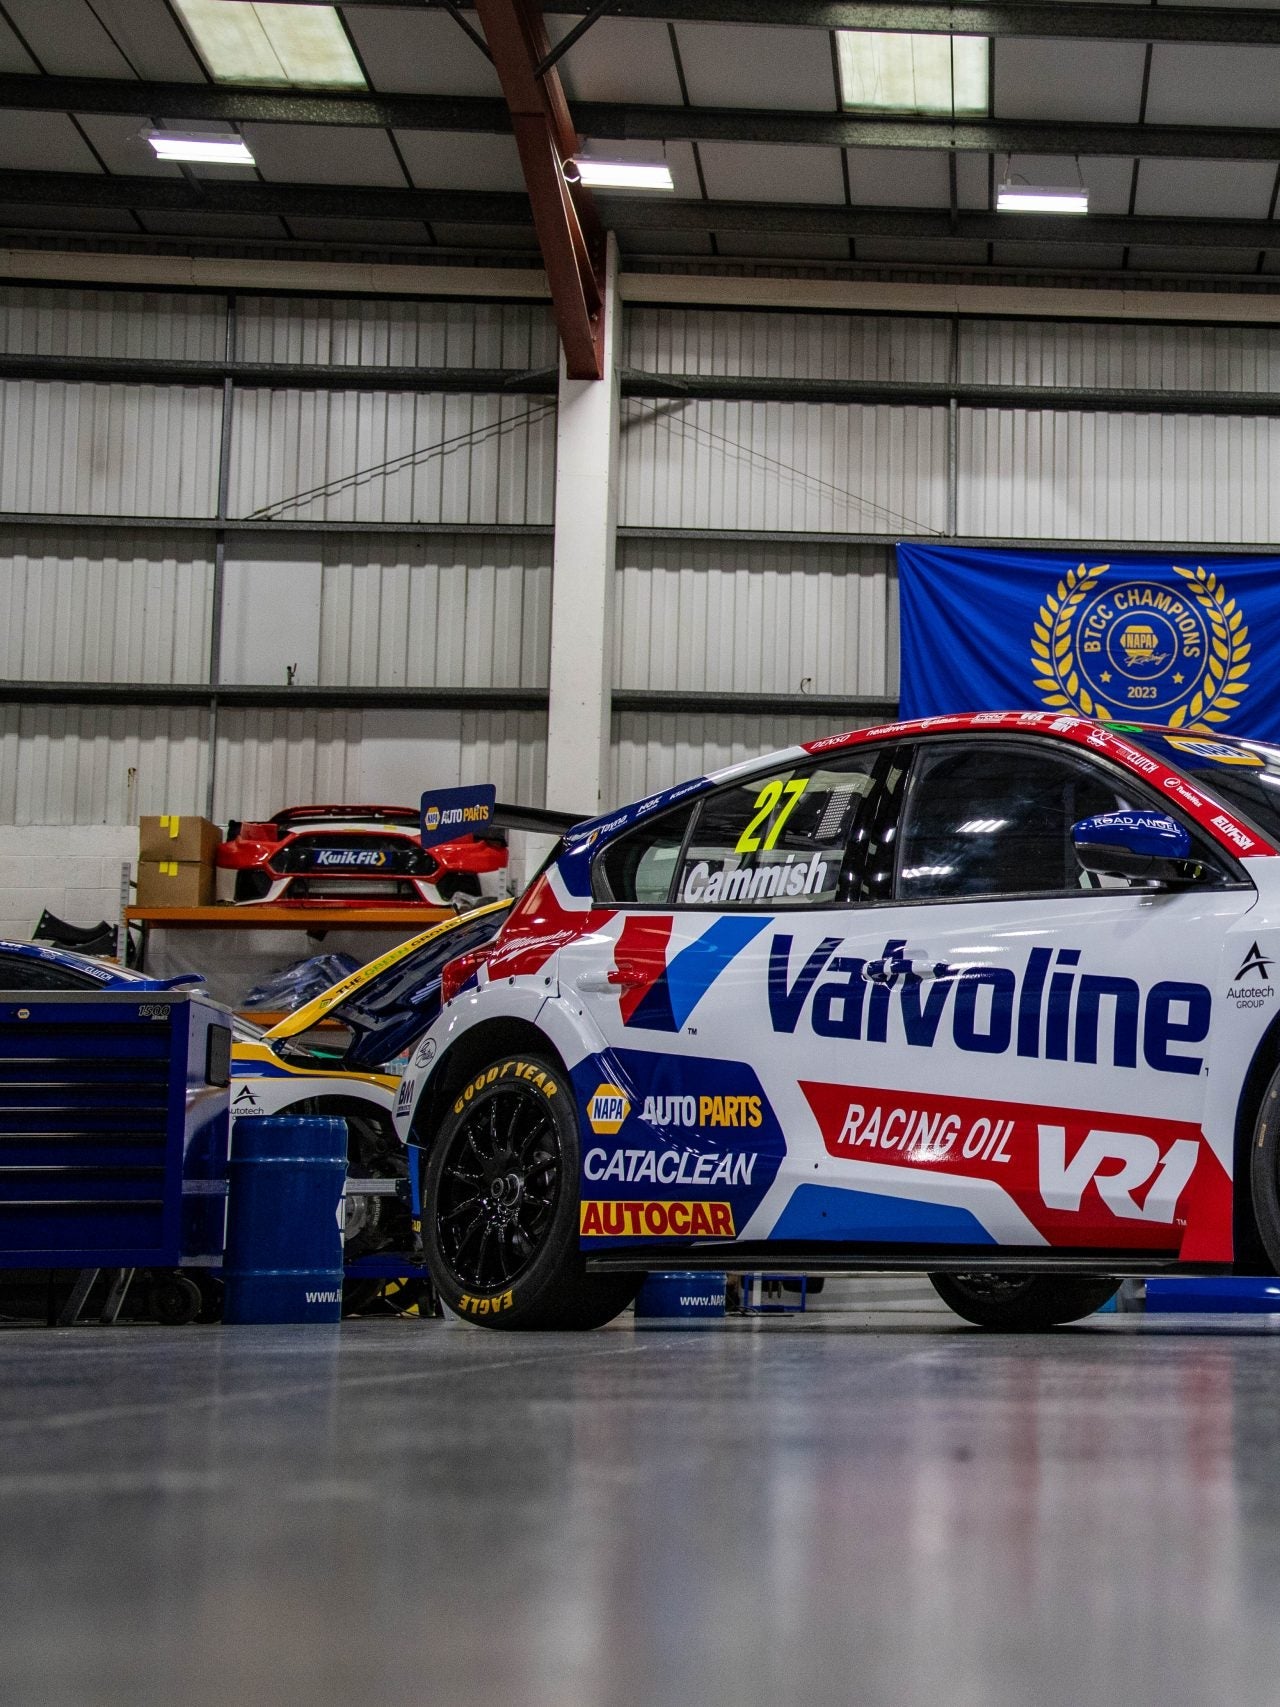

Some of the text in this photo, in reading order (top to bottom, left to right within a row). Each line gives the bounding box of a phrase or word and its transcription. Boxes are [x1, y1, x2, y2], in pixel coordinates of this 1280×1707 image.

[1084, 589, 1200, 658] BTCC CHAMPIONS
[1126, 633, 1154, 648] NAPA
[1124, 652, 1171, 667] Racing
[1127, 686, 1157, 698] 2023
[441, 808, 463, 825] AUTO
[463, 805, 489, 822] PARTS
[735, 778, 809, 853] 27
[1093, 817, 1181, 833] ROAD ANGEL
[684, 852, 827, 903] Cammish
[84, 965, 114, 981] CLUTCH
[336, 975, 362, 994] THE
[364, 947, 410, 977] GREEN
[768, 933, 1212, 1076] Valvoline
[1226, 985, 1275, 999] Autotech
[1236, 1000, 1264, 1009] GROUP
[138, 1005, 171, 1016] 1500
[229, 1106, 265, 1115] utotech
[593, 1095, 763, 1128] NAPA AUTO PARTS
[837, 1102, 1015, 1164] RACING OIL
[584, 1147, 757, 1187] CATACLEAN
[1037, 1124, 1200, 1225] VR1
[581, 1201, 735, 1236] AUTOCAR
[458, 1290, 513, 1315] EAGLE
